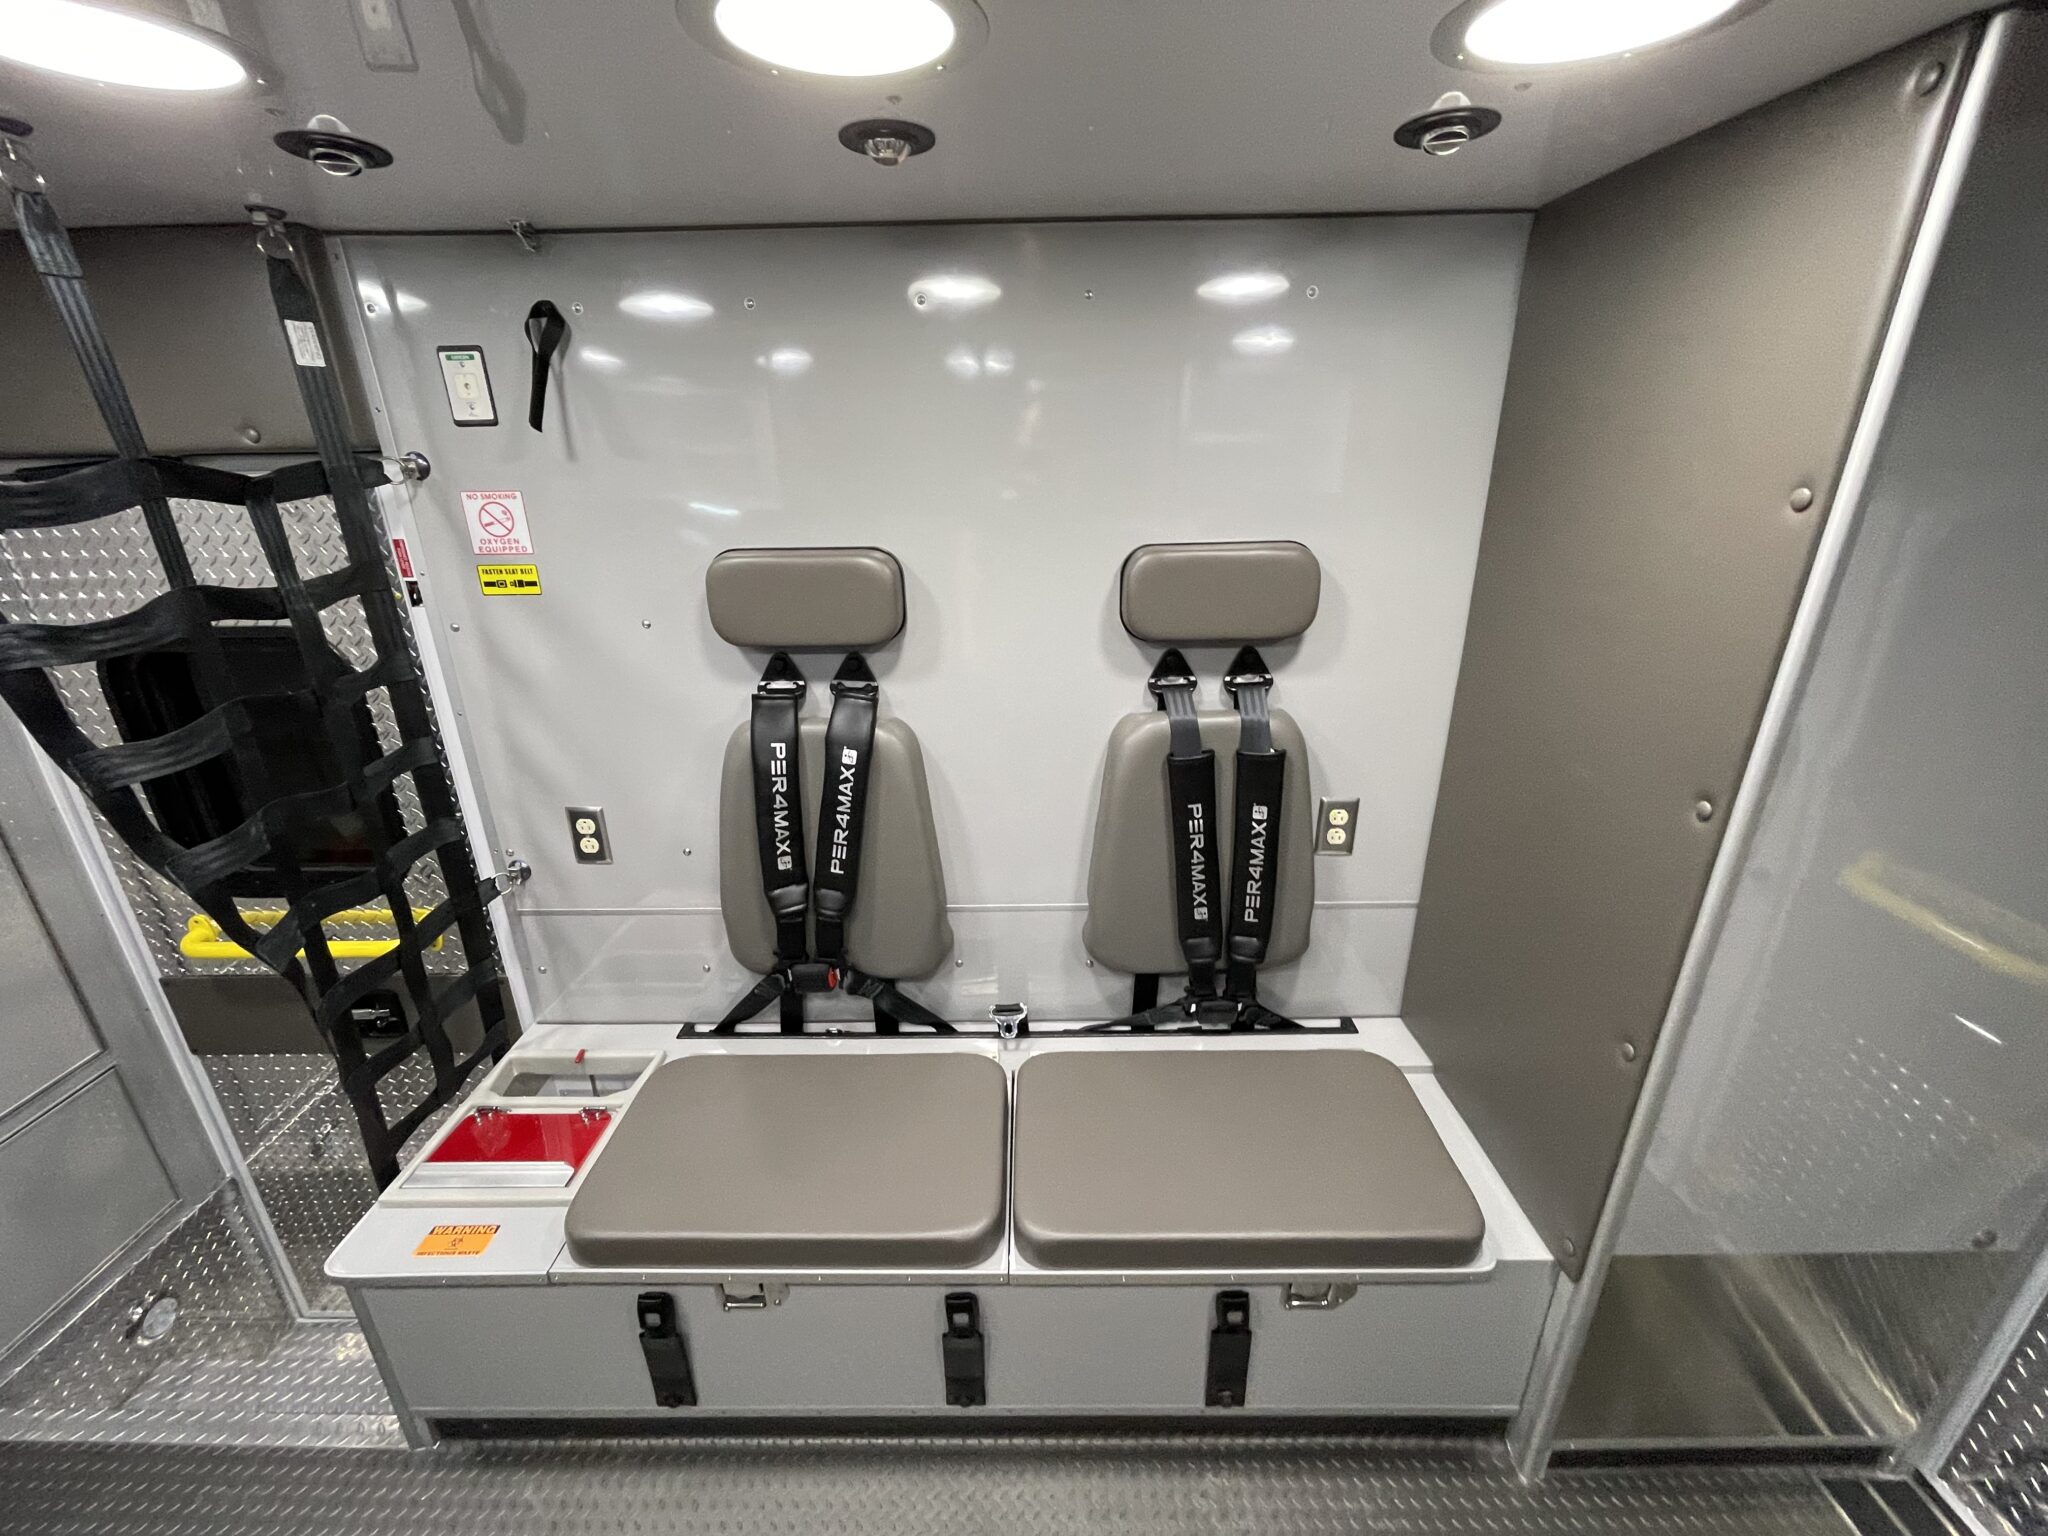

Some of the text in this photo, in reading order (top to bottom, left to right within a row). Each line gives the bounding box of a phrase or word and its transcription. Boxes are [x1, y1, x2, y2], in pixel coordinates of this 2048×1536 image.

[478, 545, 528, 553] EQUIPPED
[770, 742, 792, 855] PER4MAX
[830, 765, 856, 875] PER4MAX
[1187, 802, 1208, 907] PER4MAX
[1244, 820, 1268, 923] PER4MAX
[432, 1225, 497, 1235] WARNING
